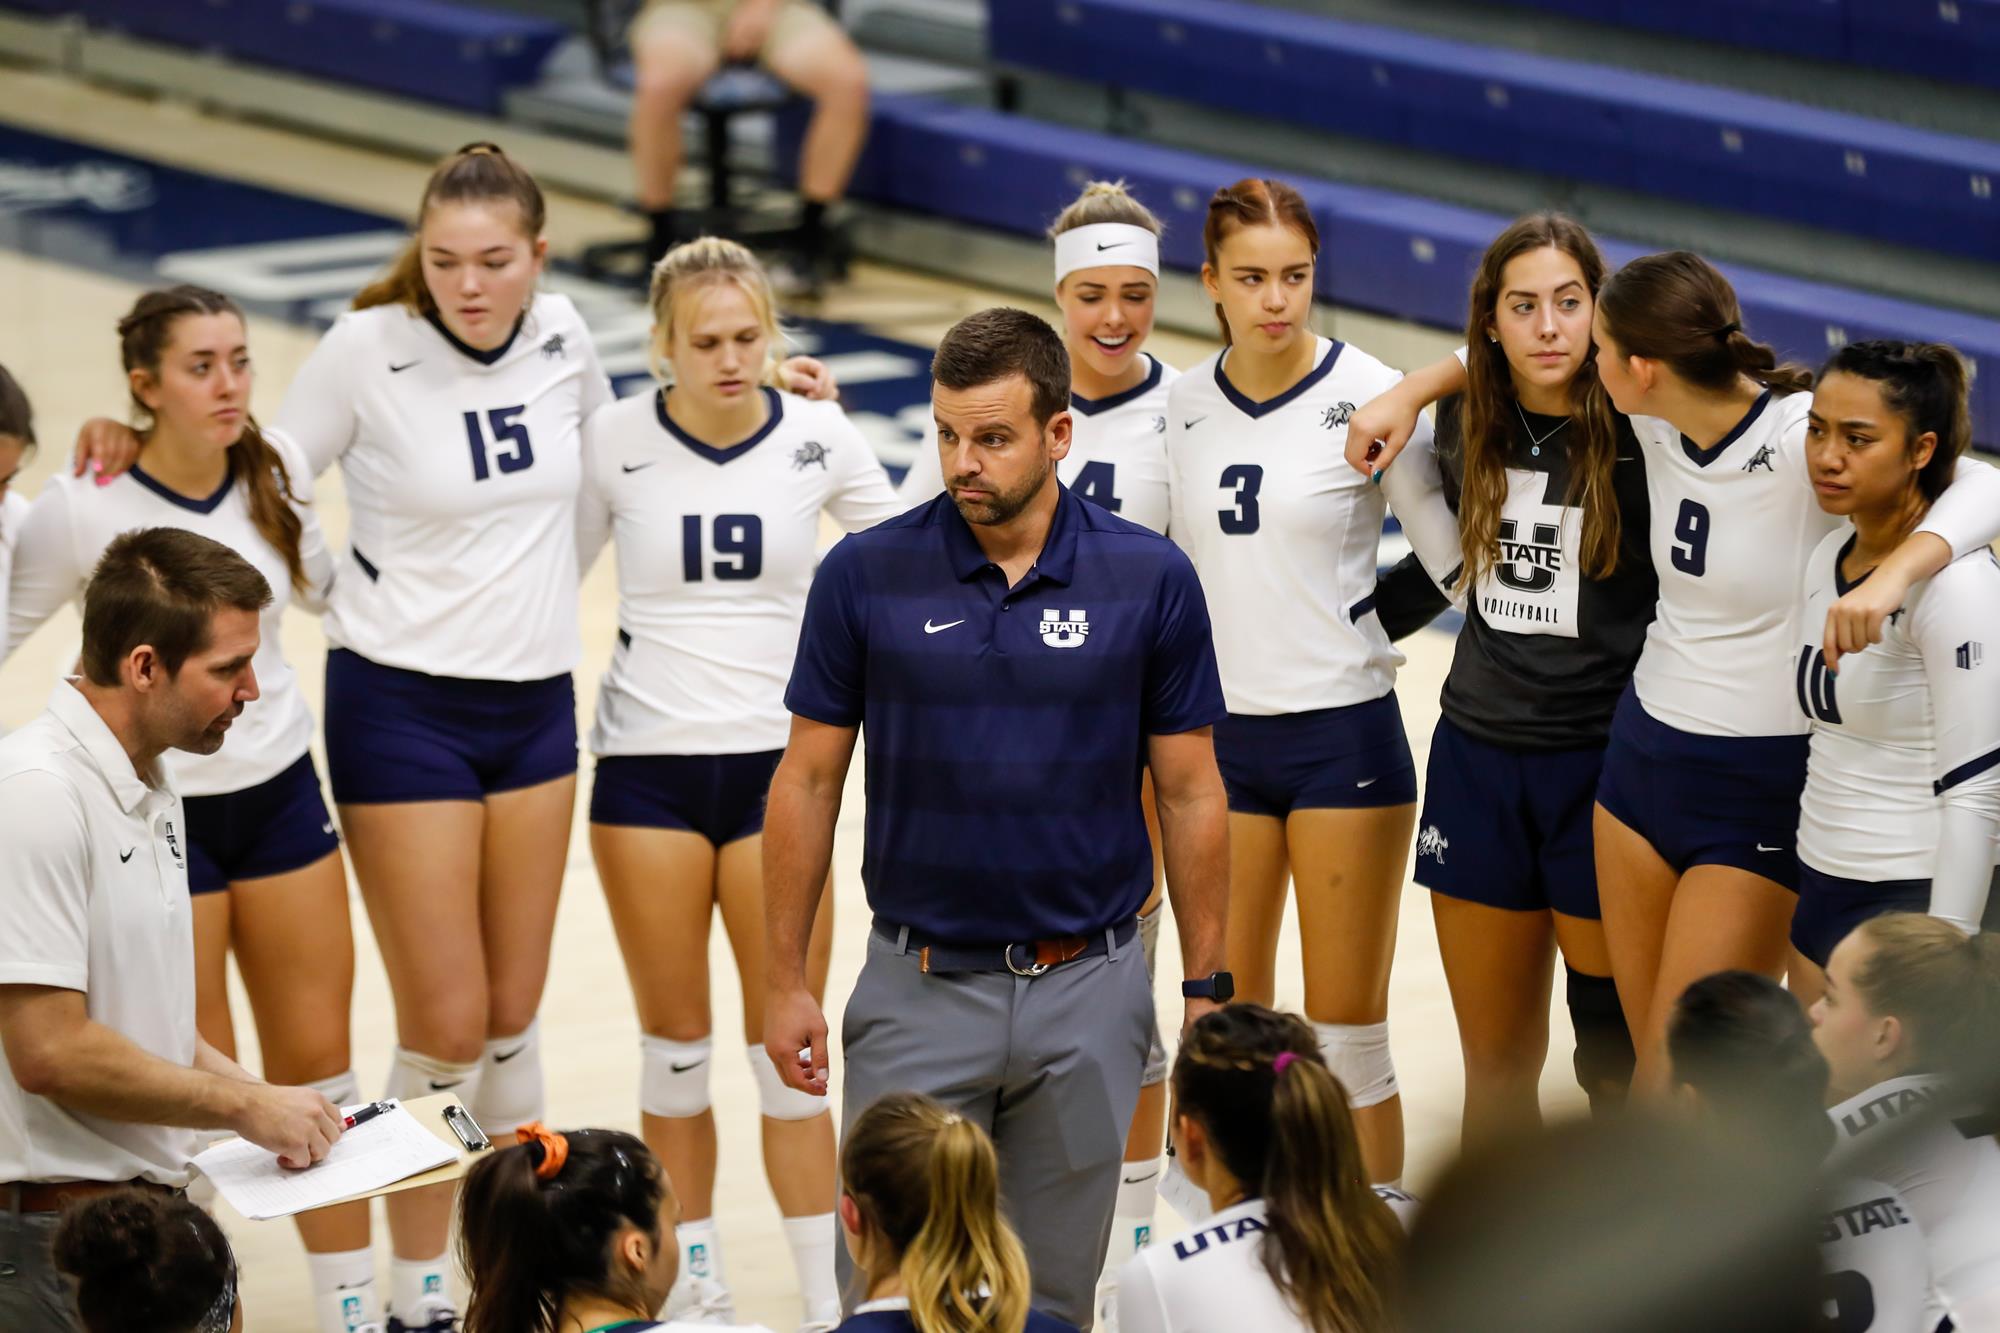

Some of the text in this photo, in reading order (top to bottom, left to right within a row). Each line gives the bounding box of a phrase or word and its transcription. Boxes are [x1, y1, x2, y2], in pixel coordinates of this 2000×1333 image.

[463, 404, 534, 481] 15
[1055, 460, 1123, 513] 4
[1217, 464, 1264, 535] 3
[682, 514, 762, 582] 19
[1495, 540, 1561, 572] TATE
[1671, 498, 1710, 577] 9
[1039, 621, 1089, 635] STATE
[1043, 608, 1086, 648] U
[1484, 597, 1558, 624] VOLLEYBALL
[1797, 645, 1843, 725] 10
[1842, 1087, 1934, 1137] UTA
[1173, 1217, 1268, 1261] UTA
